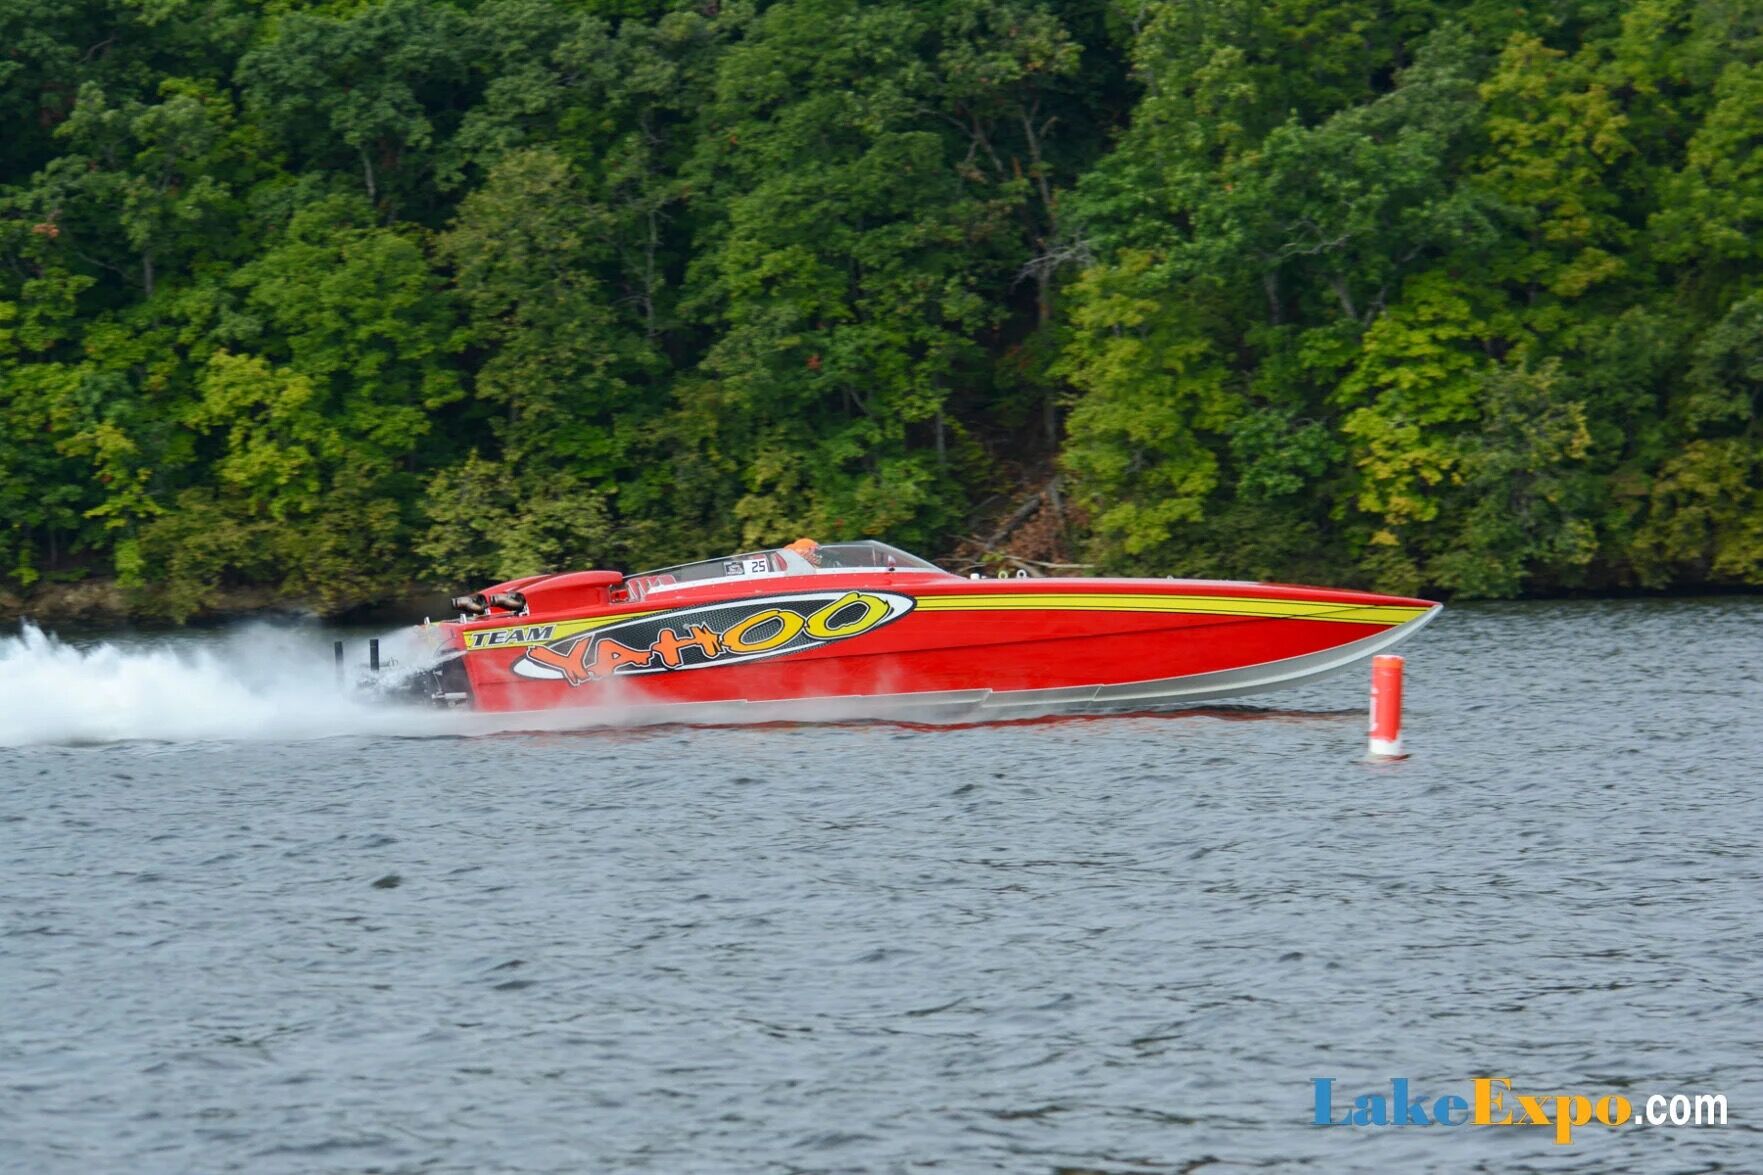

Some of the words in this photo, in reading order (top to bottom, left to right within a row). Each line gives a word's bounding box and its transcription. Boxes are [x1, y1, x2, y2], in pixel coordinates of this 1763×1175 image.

[752, 560, 766, 573] 25
[470, 625, 555, 648] TEAM
[527, 592, 889, 686] YAHOO
